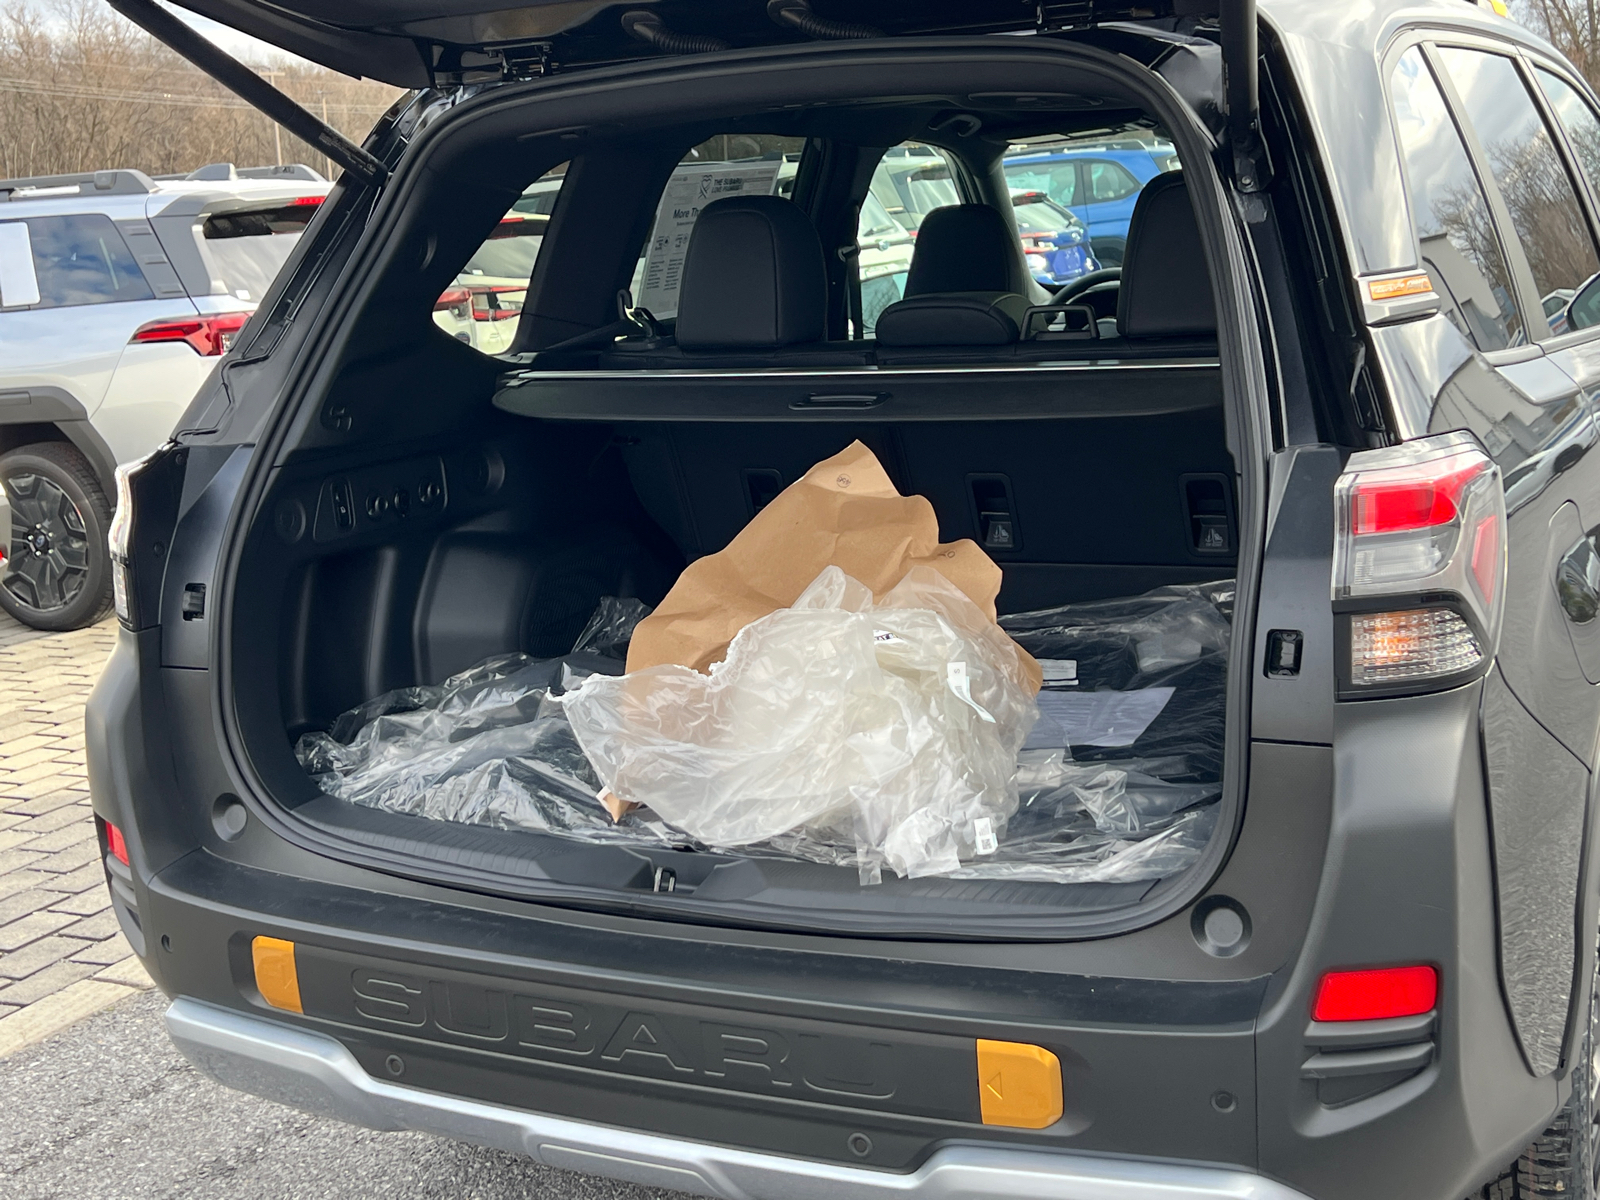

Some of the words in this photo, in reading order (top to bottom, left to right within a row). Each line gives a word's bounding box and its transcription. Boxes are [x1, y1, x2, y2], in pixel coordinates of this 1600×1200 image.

[713, 178, 723, 186] THE
[724, 177, 743, 186] SUBARU
[673, 208, 690, 219] More
[691, 207, 701, 217] Th
[351, 968, 897, 1101] SUBARU
